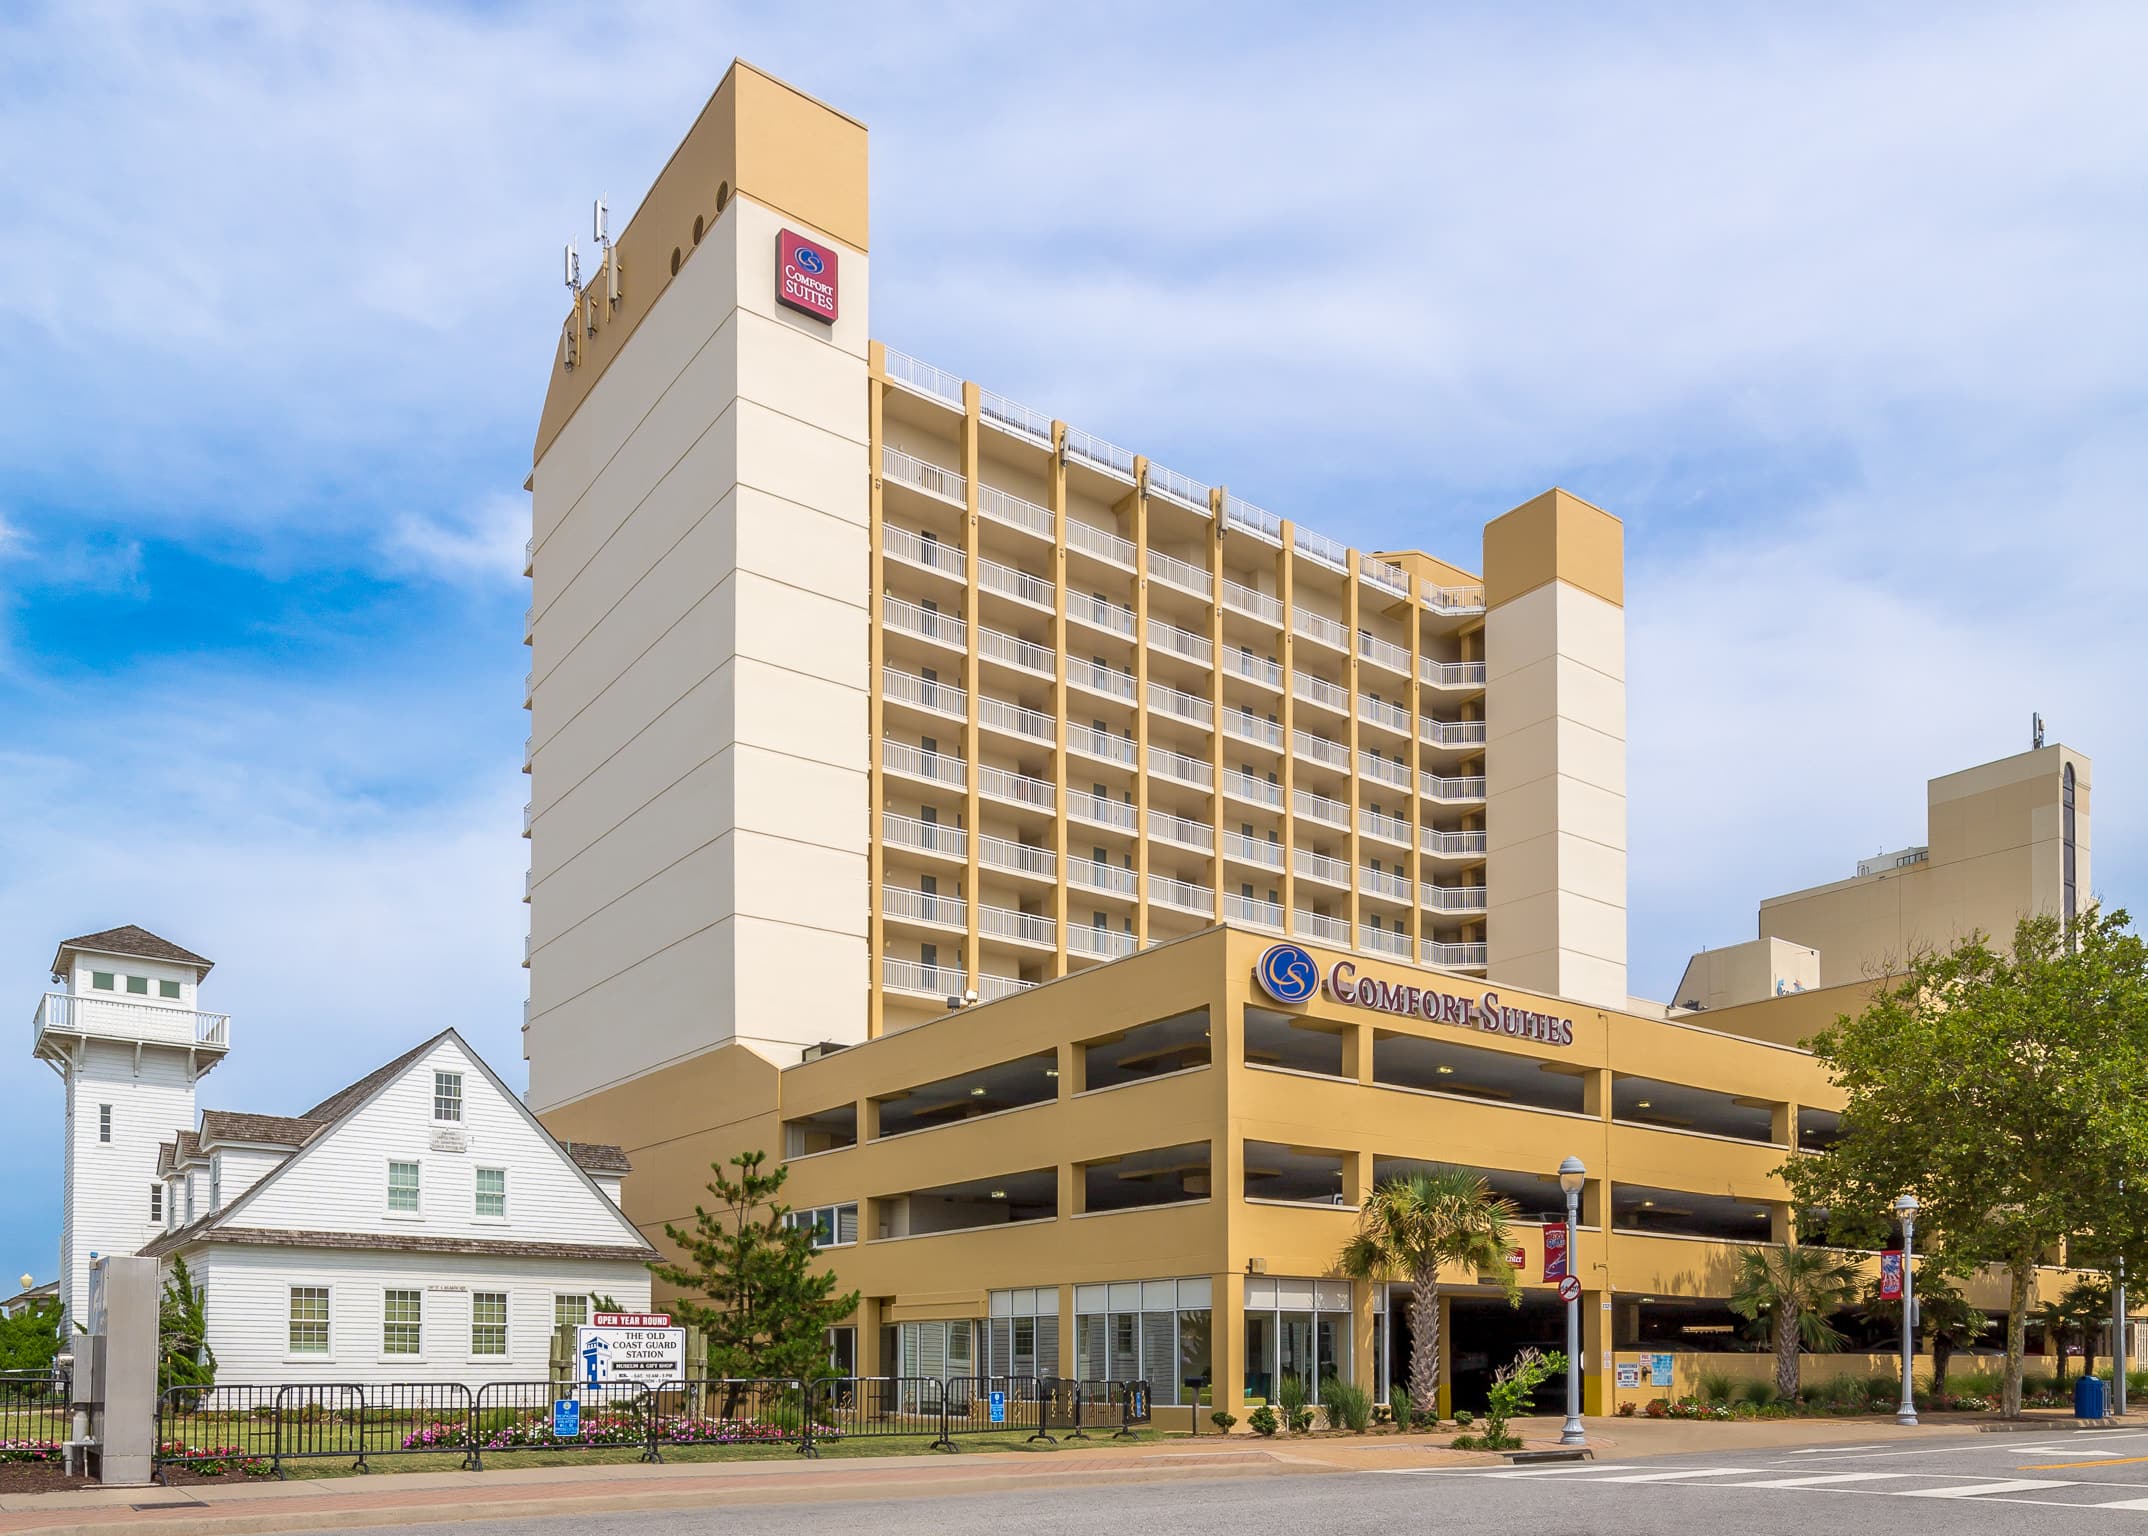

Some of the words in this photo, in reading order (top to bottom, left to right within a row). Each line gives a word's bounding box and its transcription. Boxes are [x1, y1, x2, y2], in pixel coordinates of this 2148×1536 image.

[785, 265, 833, 296] COMFORT
[786, 280, 833, 310] SUITES
[1330, 961, 1473, 1025] COMFORT
[1480, 992, 1573, 1045] SUITES
[597, 1316, 618, 1325] OPEN
[620, 1316, 640, 1325] YEAR
[642, 1316, 668, 1326] ROUND
[625, 1332, 644, 1340] THE
[646, 1332, 666, 1340] OLD
[612, 1341, 642, 1349] COAST
[645, 1341, 677, 1349] GUARD
[626, 1350, 664, 1358] STATION
